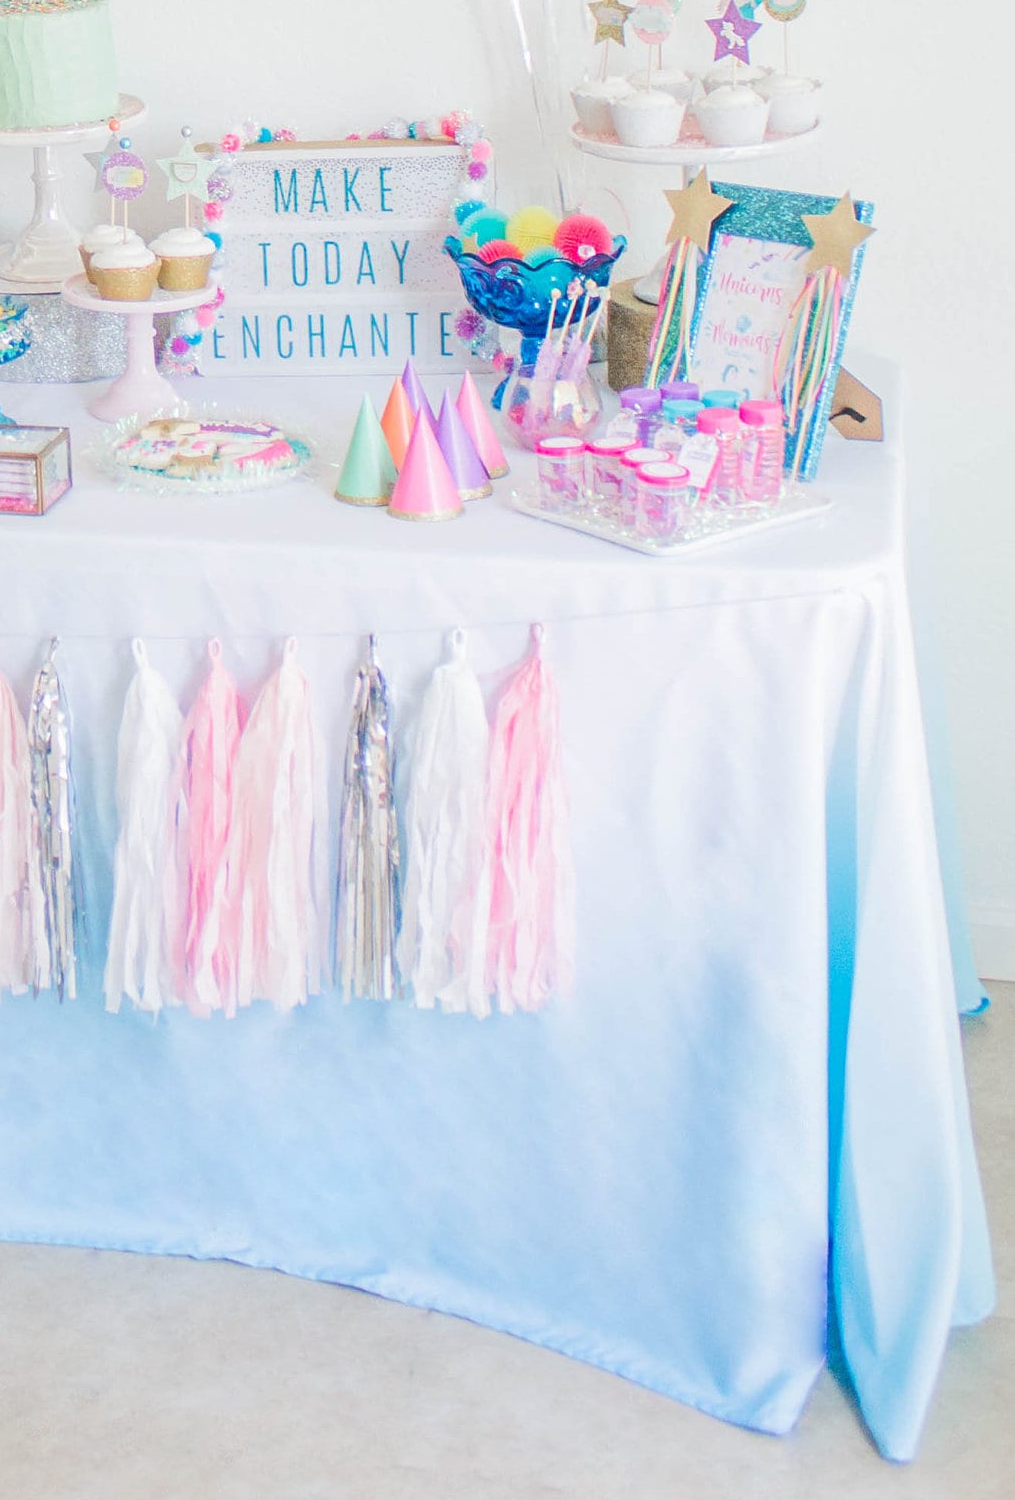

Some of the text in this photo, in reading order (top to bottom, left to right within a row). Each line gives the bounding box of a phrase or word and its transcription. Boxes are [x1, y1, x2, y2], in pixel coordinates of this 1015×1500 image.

[274, 166, 394, 213] MAKE
[257, 240, 410, 287] TODAY
[213, 312, 479, 360] ENCHANTE
